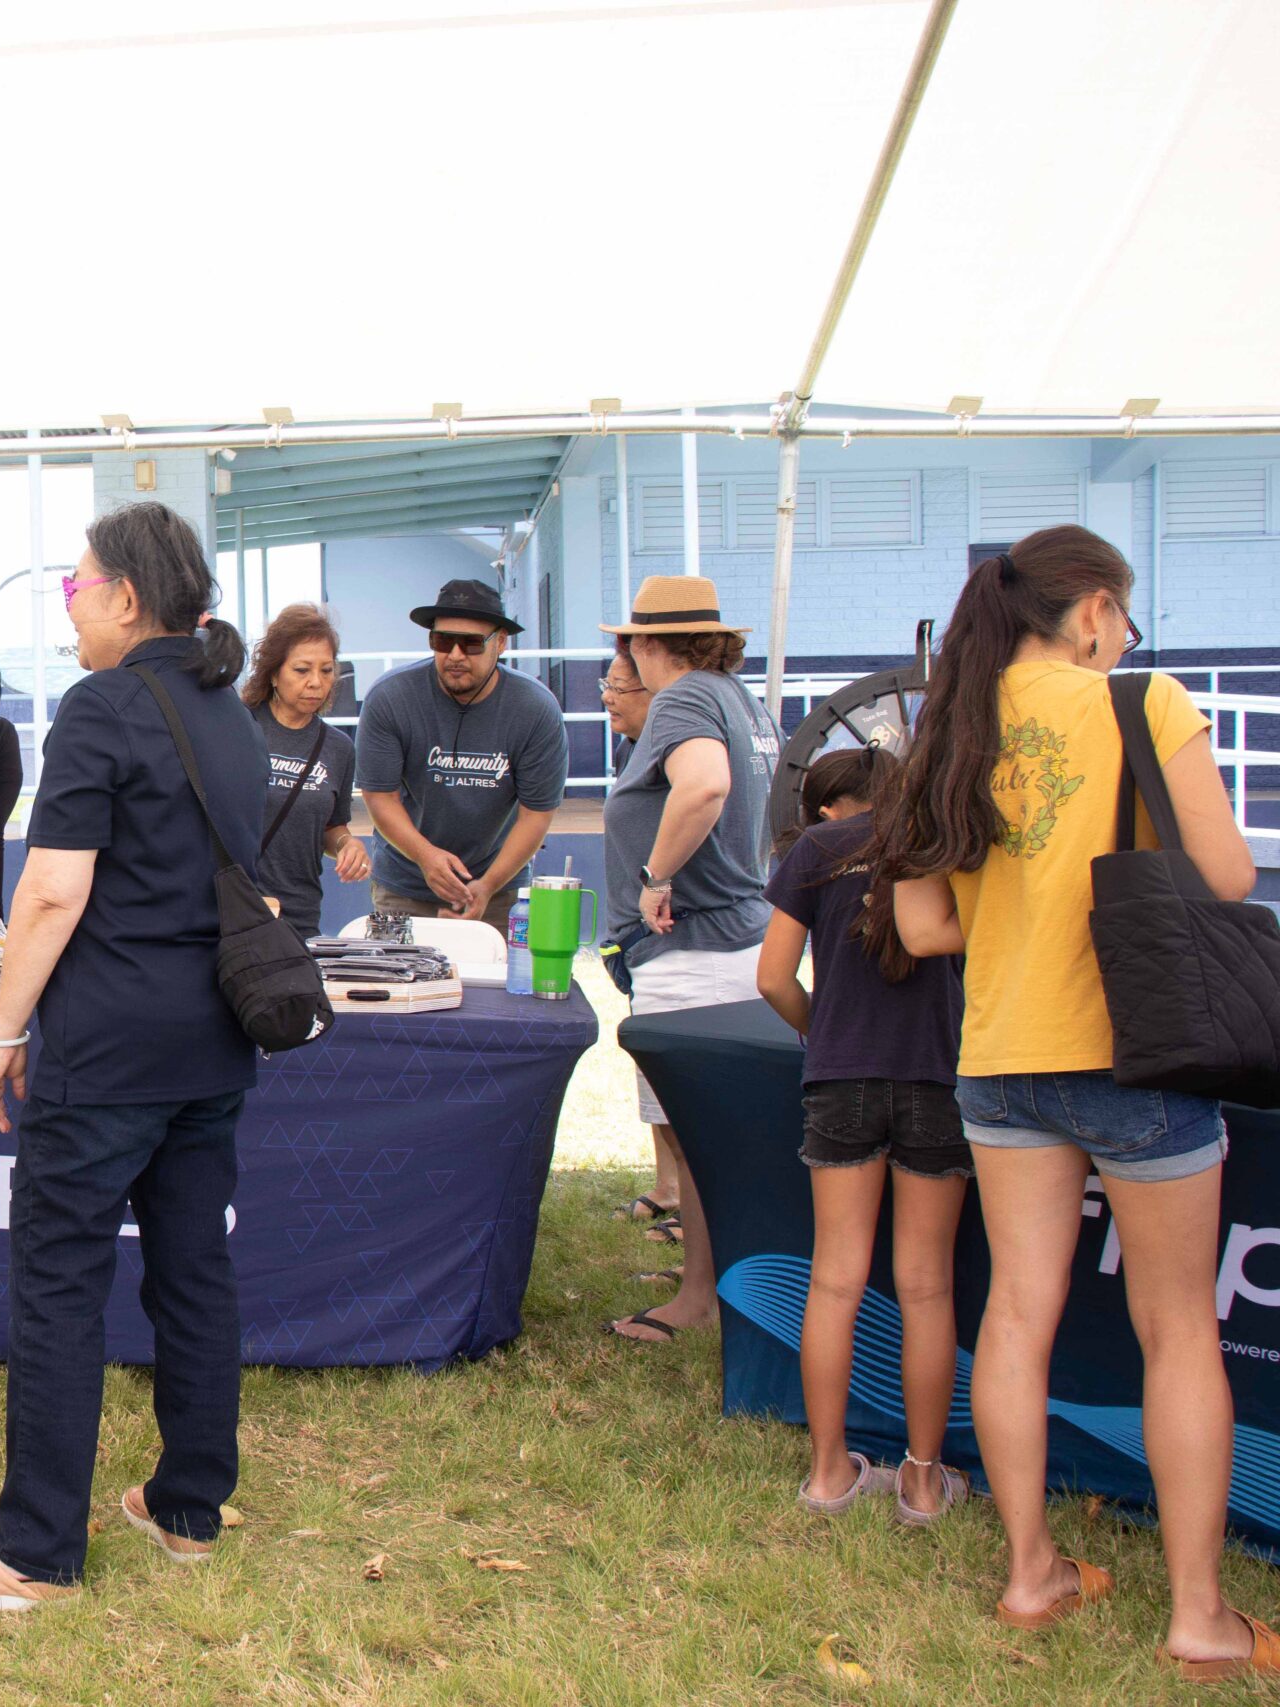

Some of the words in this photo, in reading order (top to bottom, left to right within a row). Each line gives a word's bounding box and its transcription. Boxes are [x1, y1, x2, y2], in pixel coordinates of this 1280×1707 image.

[427, 745, 510, 780] Community
[277, 778, 320, 791] ALTES.
[1219, 1340, 1280, 1362] owere
